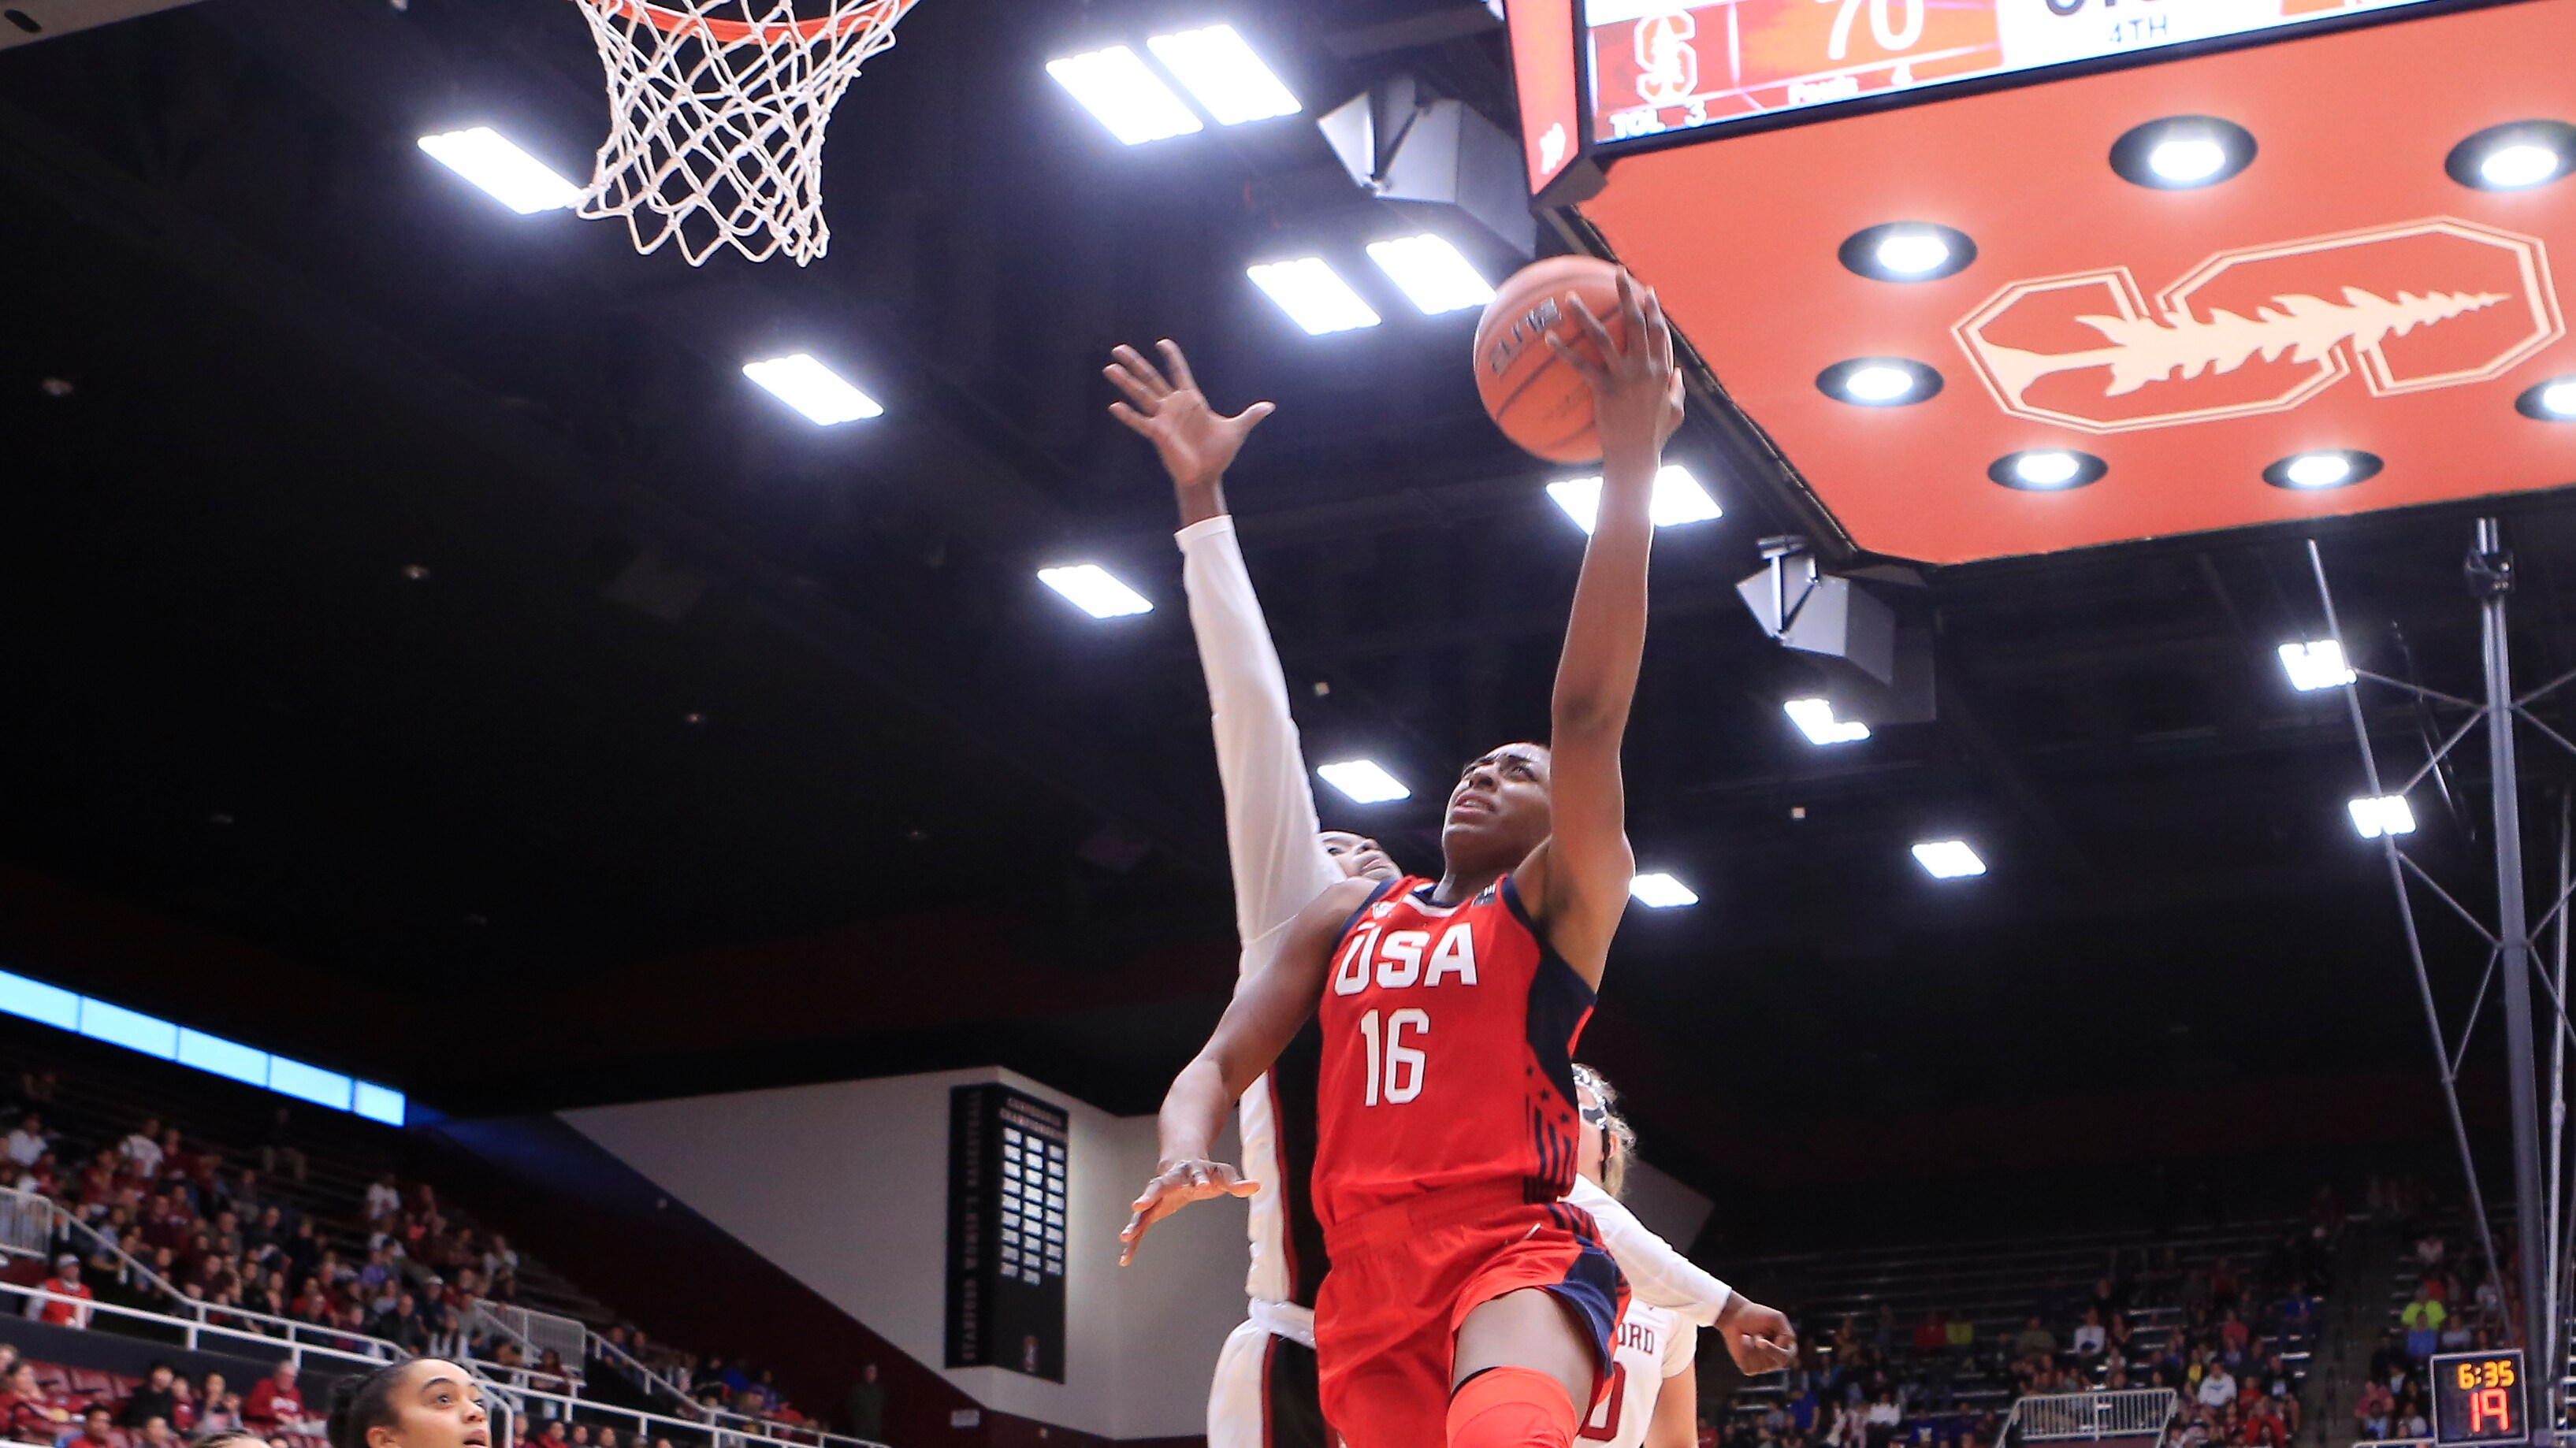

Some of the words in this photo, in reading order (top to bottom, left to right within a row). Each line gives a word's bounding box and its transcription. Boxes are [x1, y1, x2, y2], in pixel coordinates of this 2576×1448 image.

[1815, 0, 1924, 60] 70
[2109, 14, 2168, 43] 4TH
[1684, 99, 1708, 127] 3
[1334, 922, 1478, 996] USA
[1360, 1008, 1430, 1107] 16
[1618, 1323, 1656, 1355] ORD
[2458, 1360, 2515, 1390] 6:35
[2470, 1388, 2510, 1432] 19
